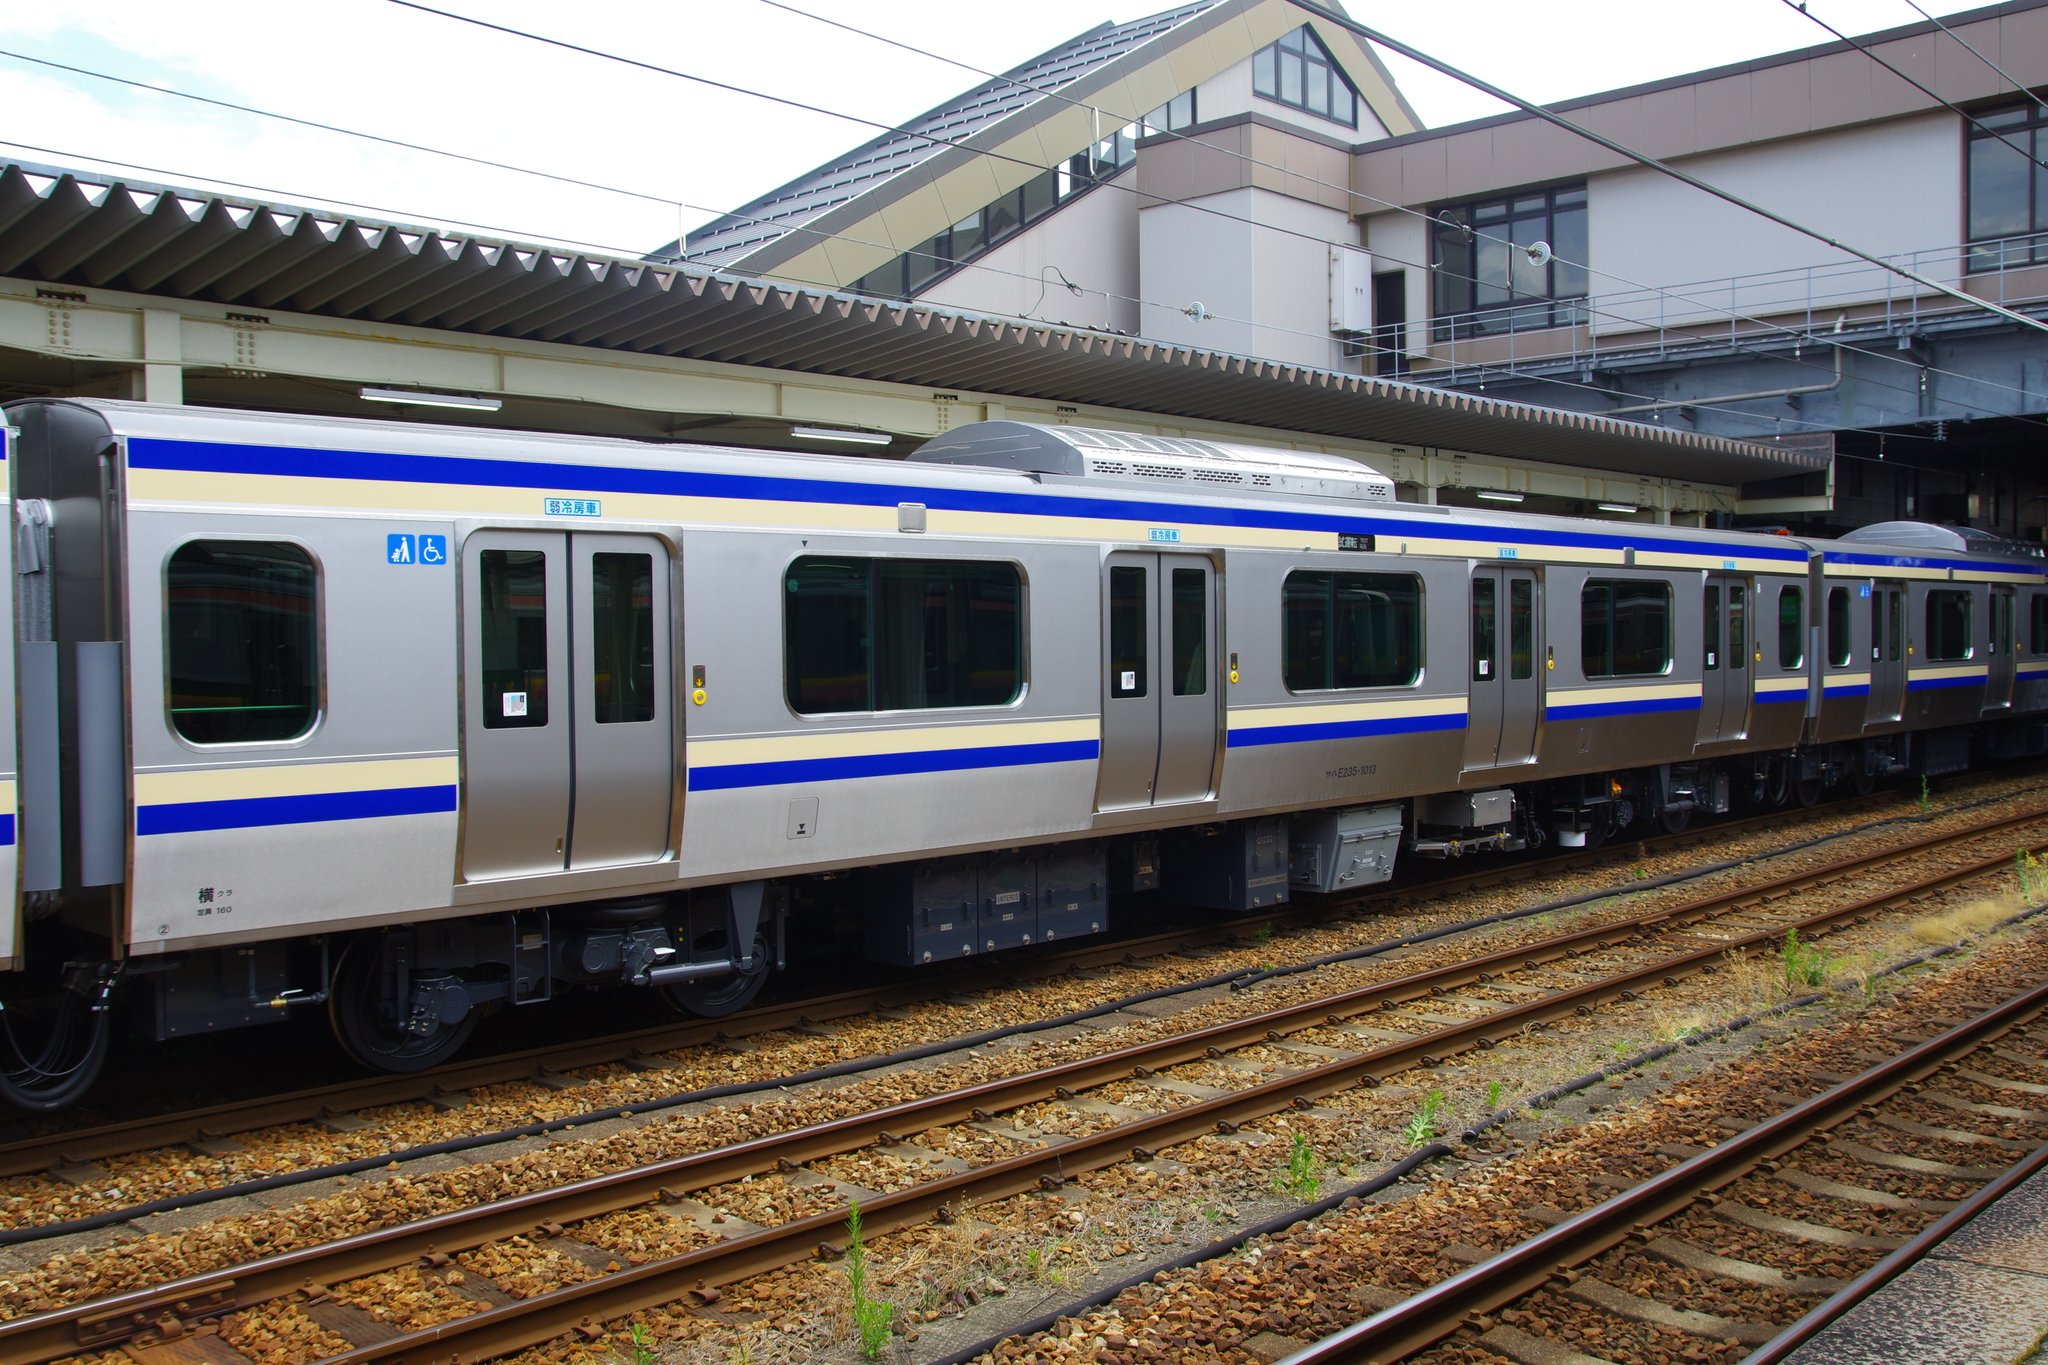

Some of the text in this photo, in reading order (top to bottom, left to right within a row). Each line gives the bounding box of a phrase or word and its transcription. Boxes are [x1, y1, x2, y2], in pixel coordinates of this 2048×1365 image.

[550, 500, 597, 514] 弱冷房車
[216, 906, 232, 914] 160
